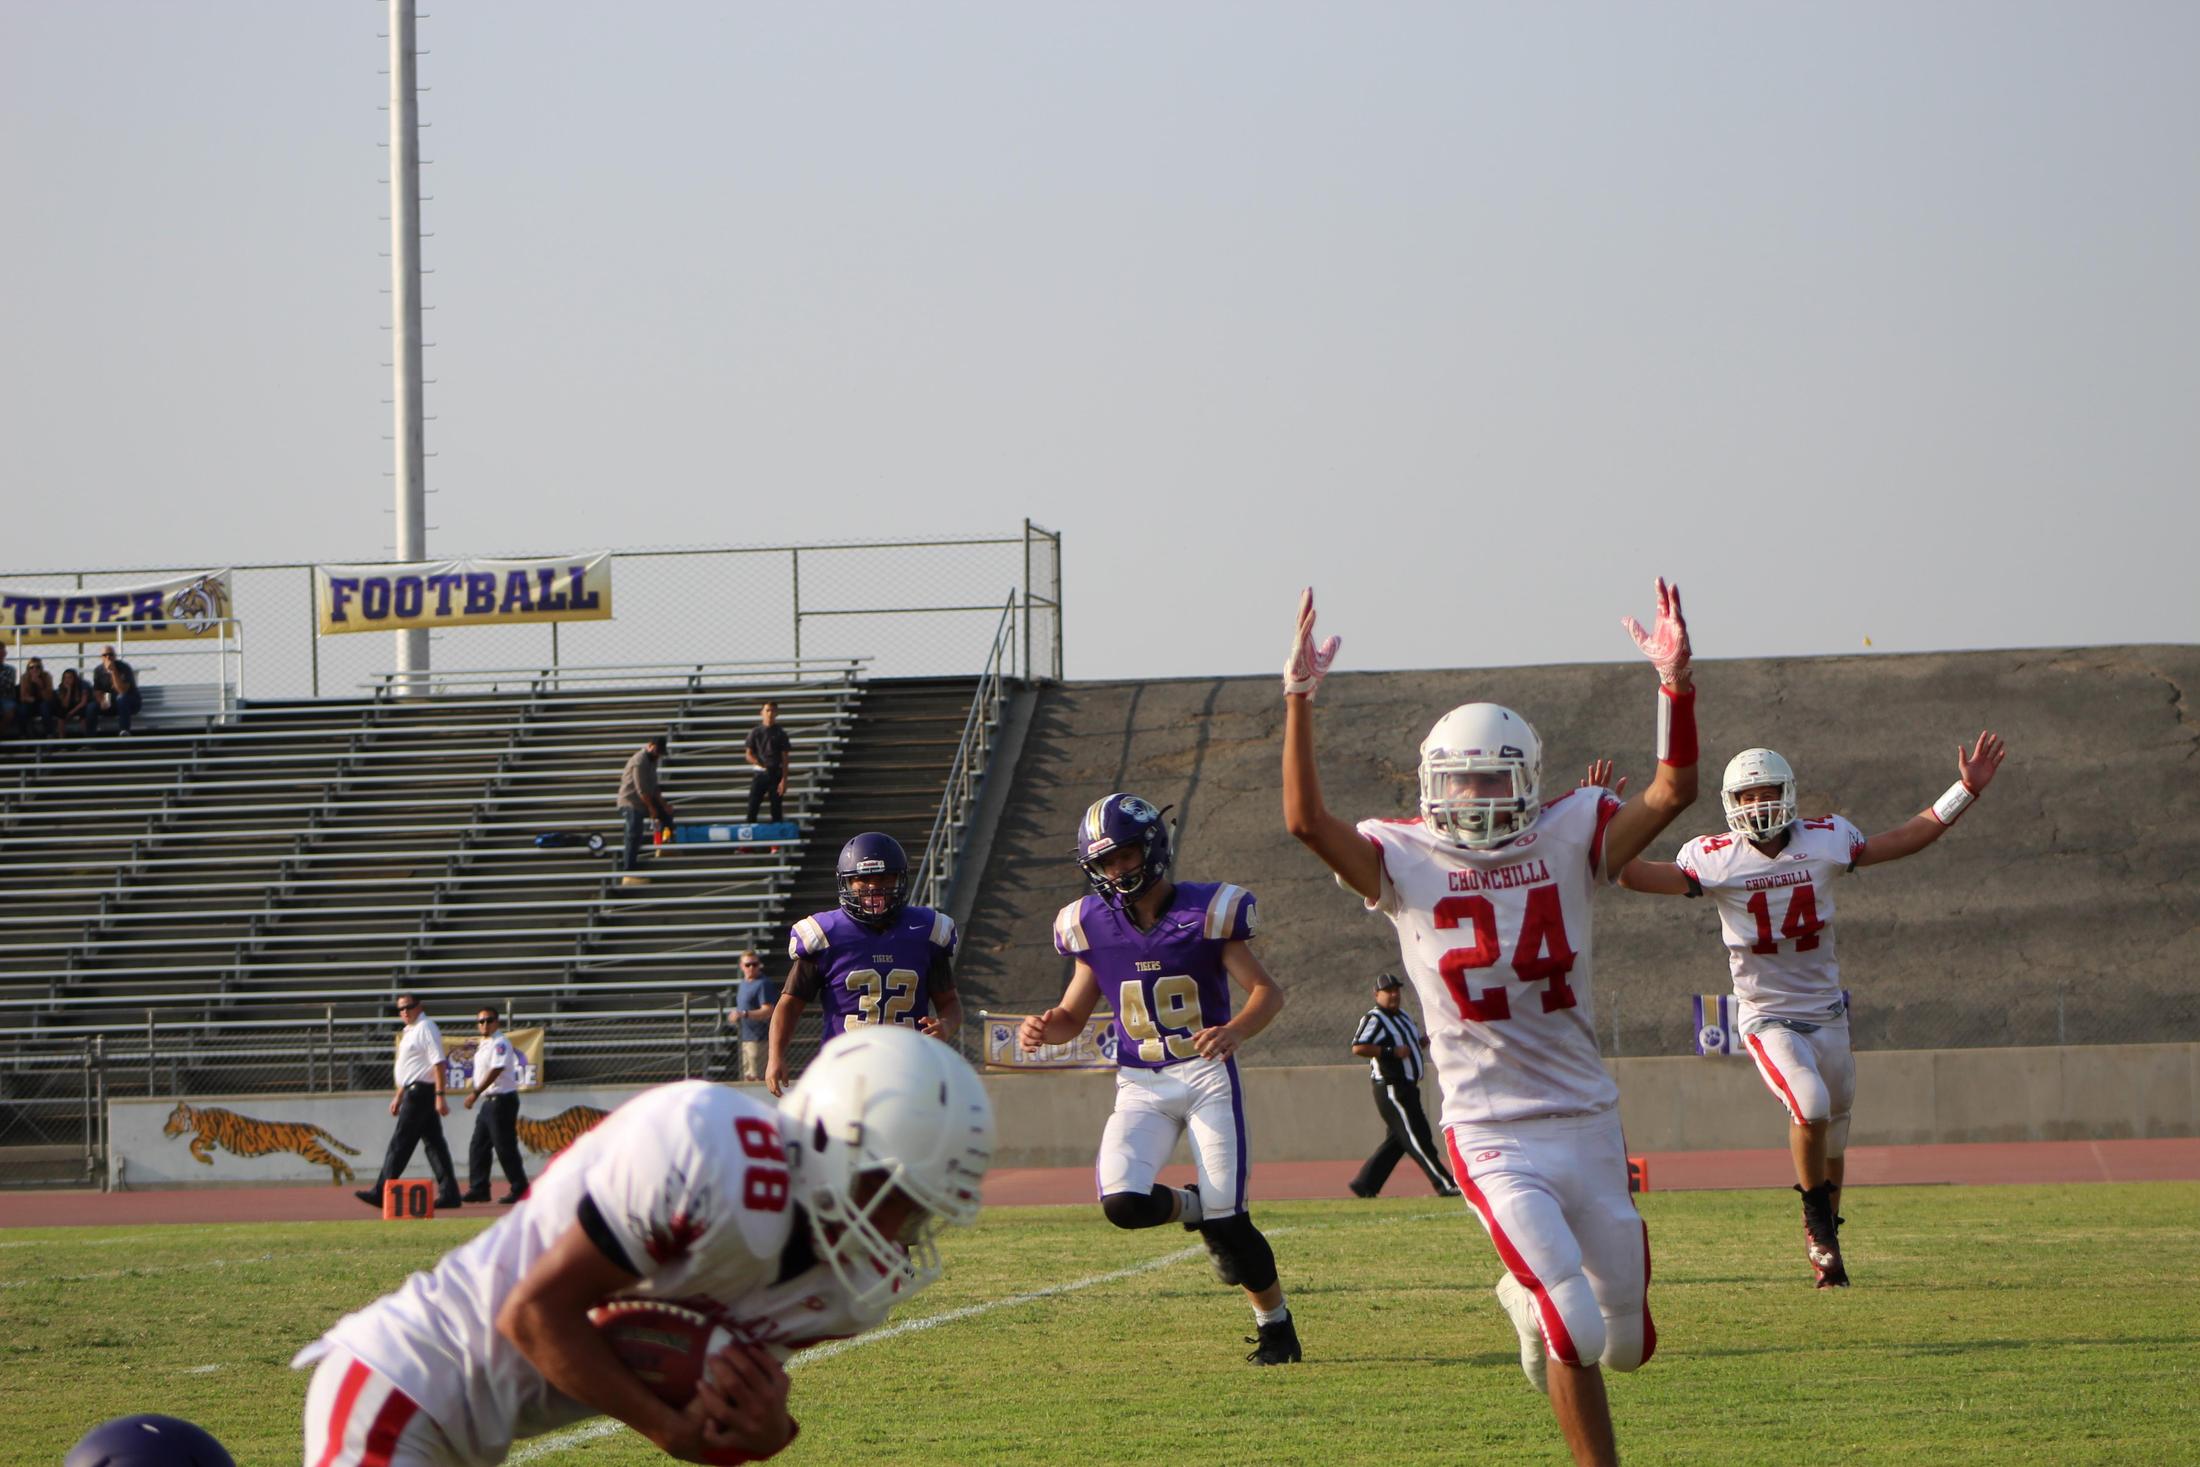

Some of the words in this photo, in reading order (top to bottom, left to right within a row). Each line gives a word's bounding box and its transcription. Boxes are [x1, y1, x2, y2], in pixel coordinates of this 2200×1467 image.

[3, 590, 167, 635] TIGER
[330, 566, 600, 622] FOOTBALL
[1448, 860, 1550, 892] CHOWCHILLA
[1745, 869, 1813, 892] CHOWCHILLA
[1747, 884, 1825, 955] 14
[871, 954, 894, 963] TIGERS
[1135, 960, 1162, 972] TIGERS
[1433, 883, 1578, 1022] 24
[844, 968, 919, 1032] 32
[1119, 974, 1204, 1062] 49
[391, 1184, 428, 1218] 10
